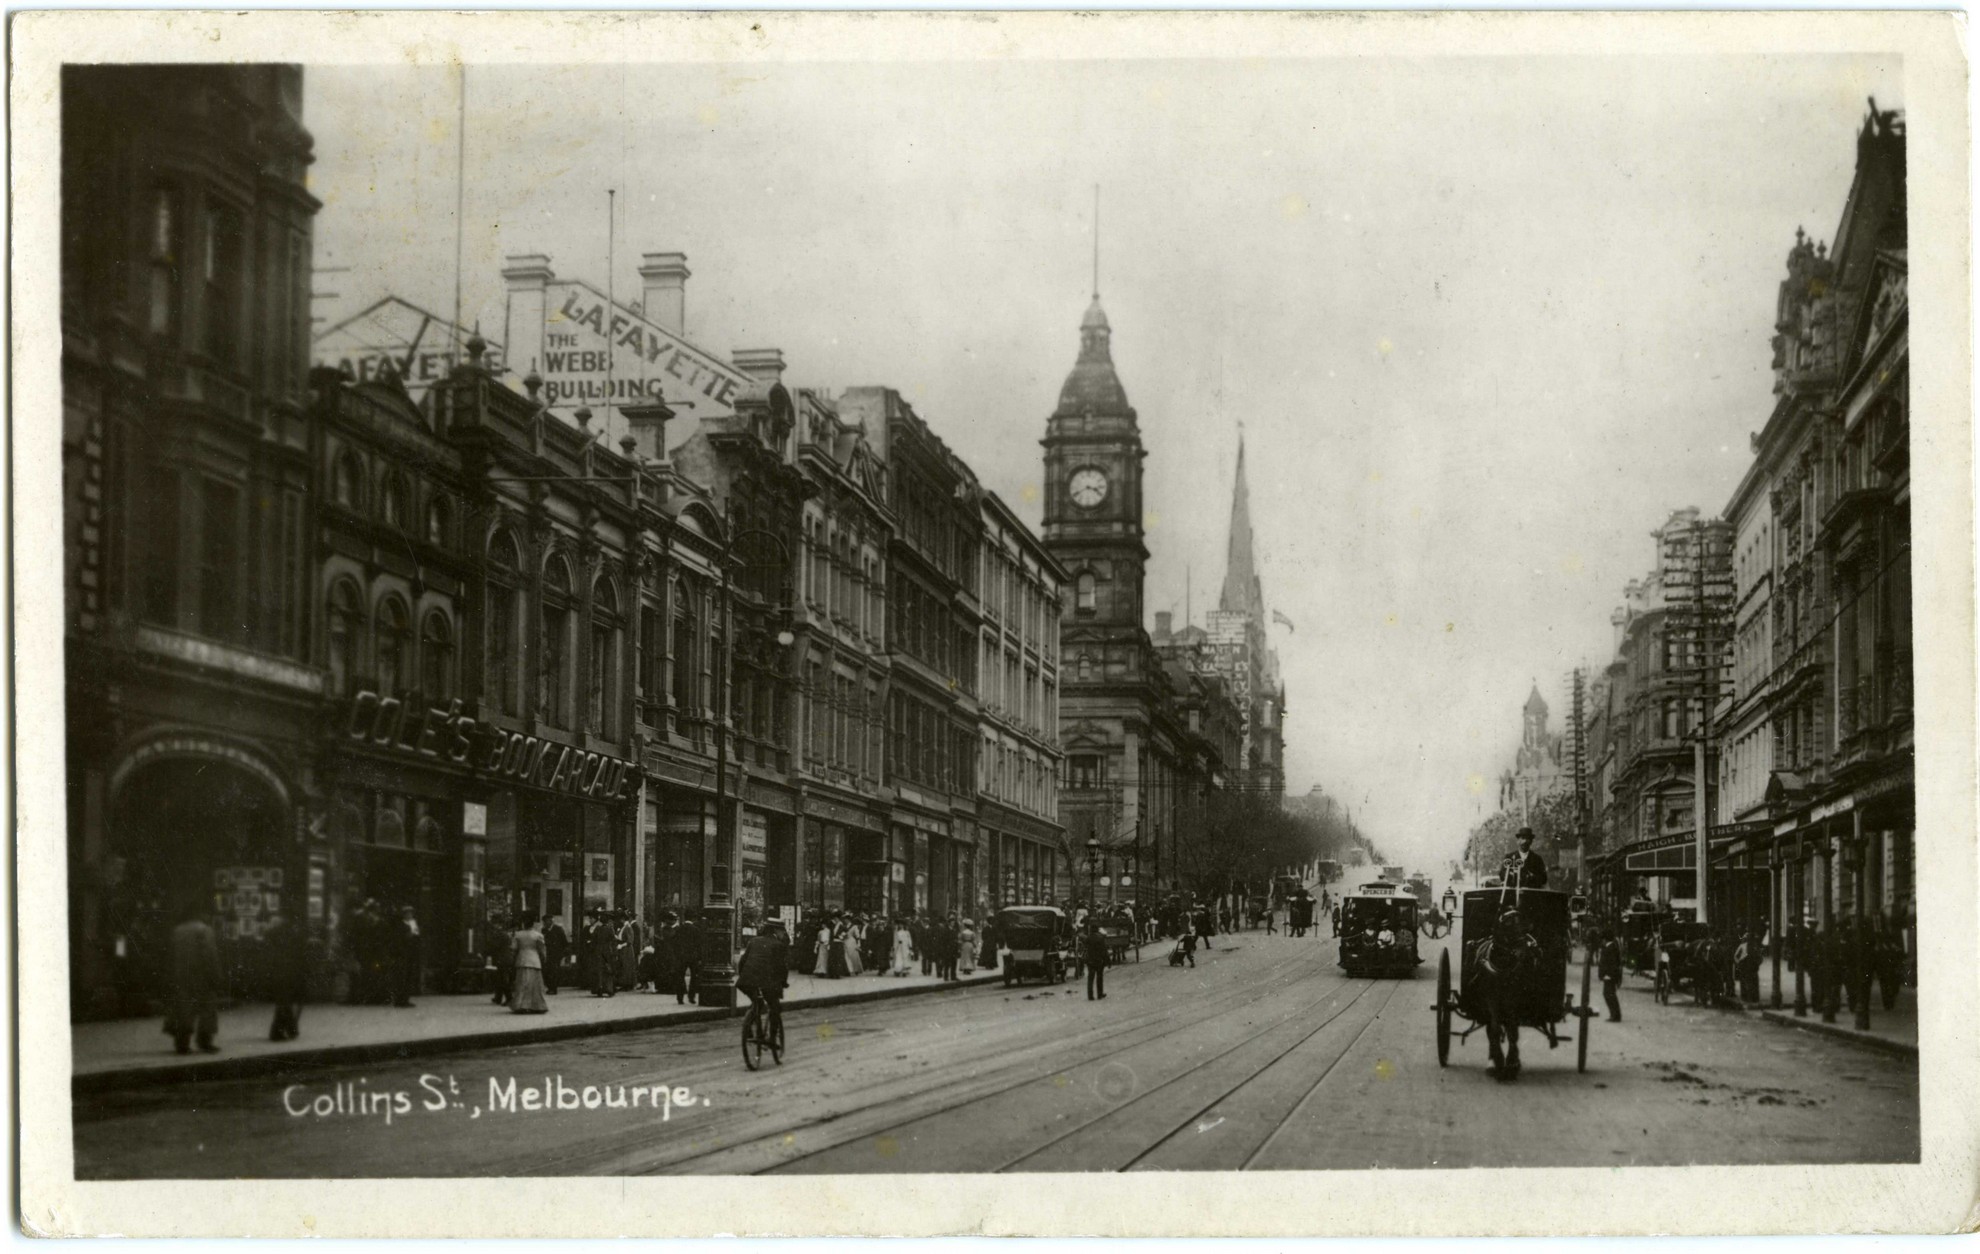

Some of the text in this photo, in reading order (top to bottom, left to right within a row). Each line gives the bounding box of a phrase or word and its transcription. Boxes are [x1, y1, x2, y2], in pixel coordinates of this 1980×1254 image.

[547, 333, 579, 348] THE
[560, 291, 741, 409] LAFAYETTE
[545, 351, 614, 373] WEBB
[545, 378, 664, 400] BUILDING
[350, 690, 637, 800] COLE'S BOOK ARCADE
[1637, 836, 1677, 852] HAIGH
